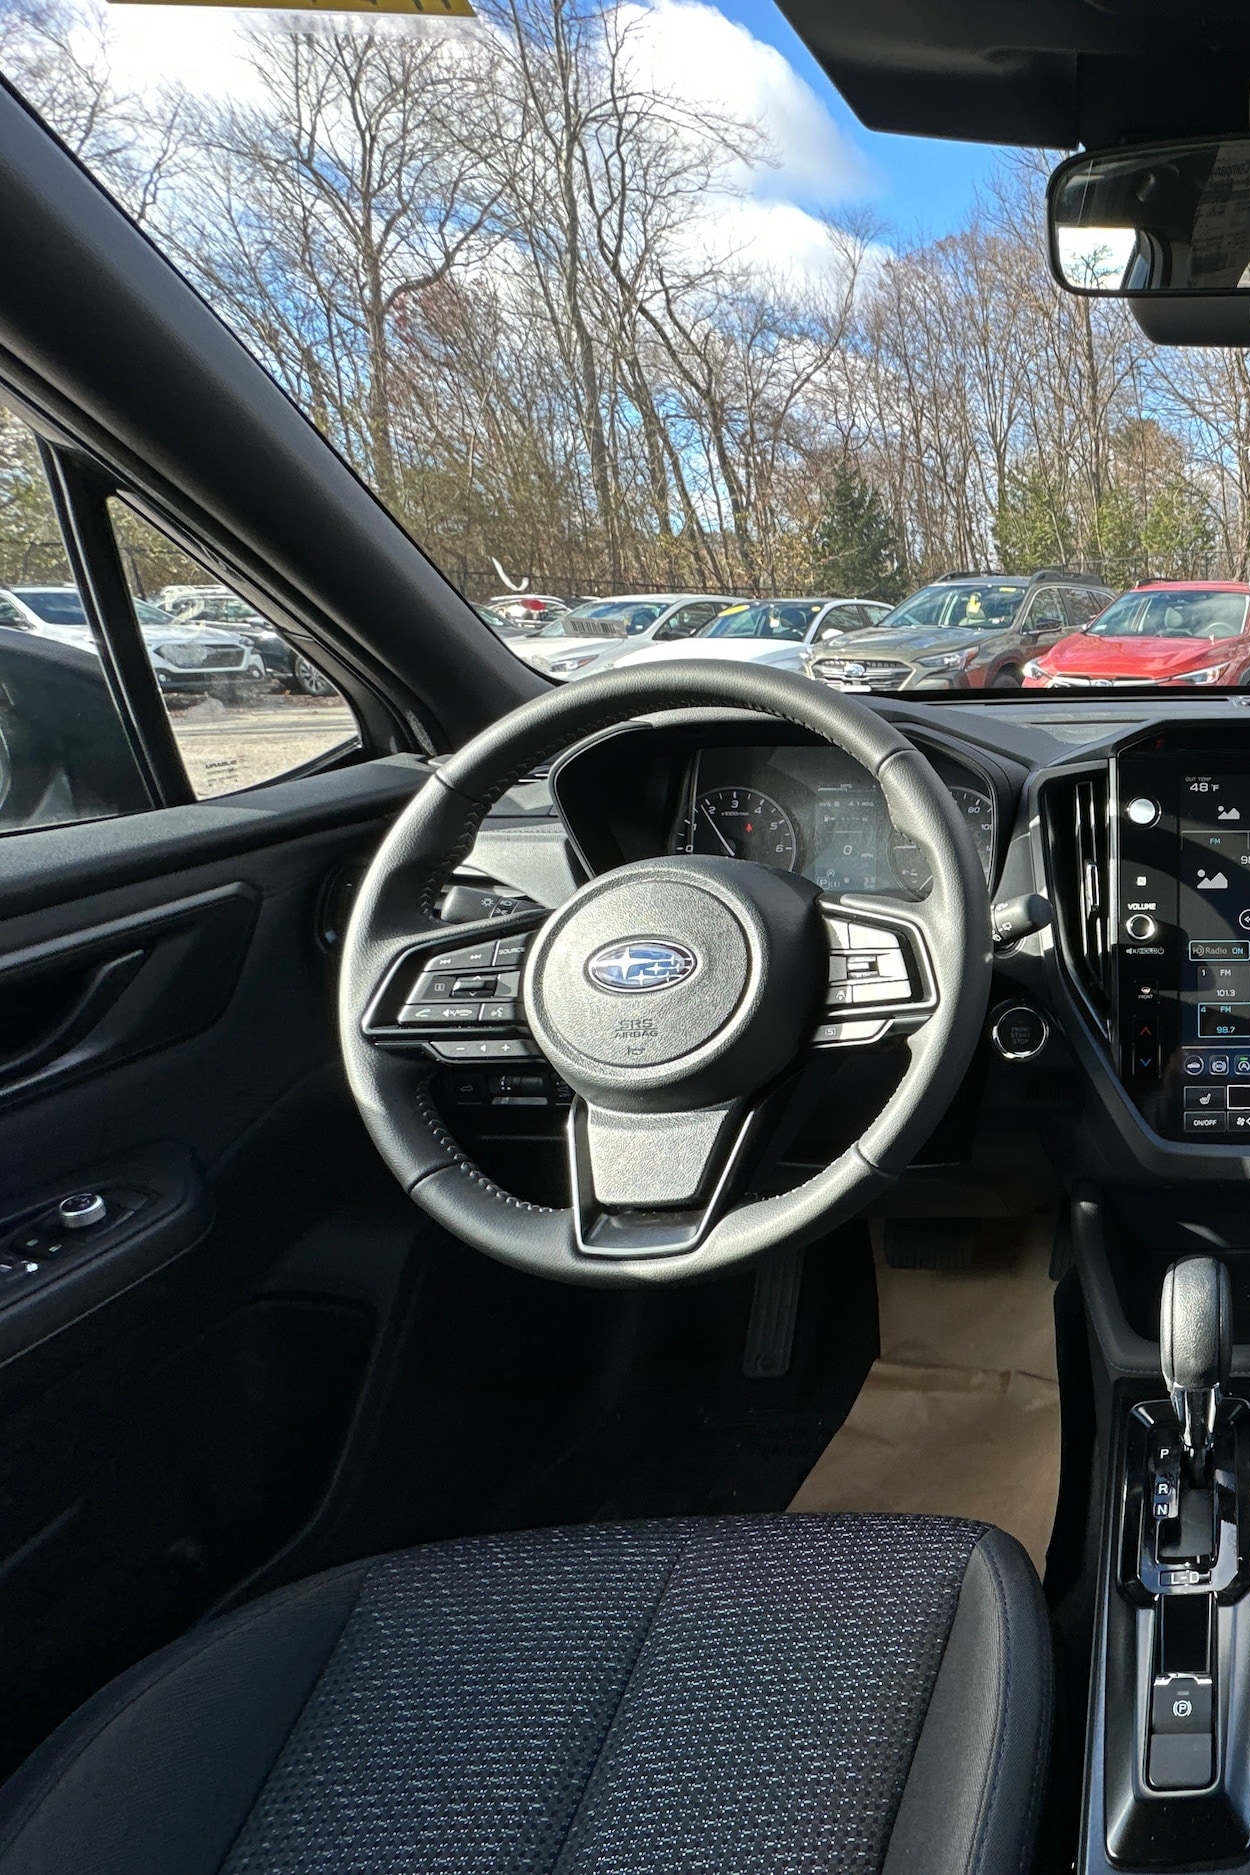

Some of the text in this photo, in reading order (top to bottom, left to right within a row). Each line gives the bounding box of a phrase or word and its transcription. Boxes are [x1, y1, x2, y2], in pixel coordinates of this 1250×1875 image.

[1189, 782, 1208, 792] 48
[730, 800, 739, 808] 3
[708, 806, 716, 814] 2
[754, 806, 762, 814] 4
[968, 806, 980, 814] 80
[770, 822, 778, 830] 5
[1210, 837, 1221, 845] FM
[685, 844, 694, 852] 0
[776, 844, 784, 852] 6
[843, 844, 852, 855] 0
[1128, 902, 1156, 910] VOLUME
[1204, 946, 1228, 955] Radio
[1232, 946, 1244, 955] ON
[620, 1019, 654, 1029] SRS
[615, 1030, 658, 1038] AIRBAG
[1216, 1026, 1236, 1034] 98.7
[1193, 1118, 1218, 1126] ON/OFF
[1160, 1448, 1170, 1460] P
[1158, 1483, 1168, 1494] R
[1157, 1504, 1167, 1515] N
